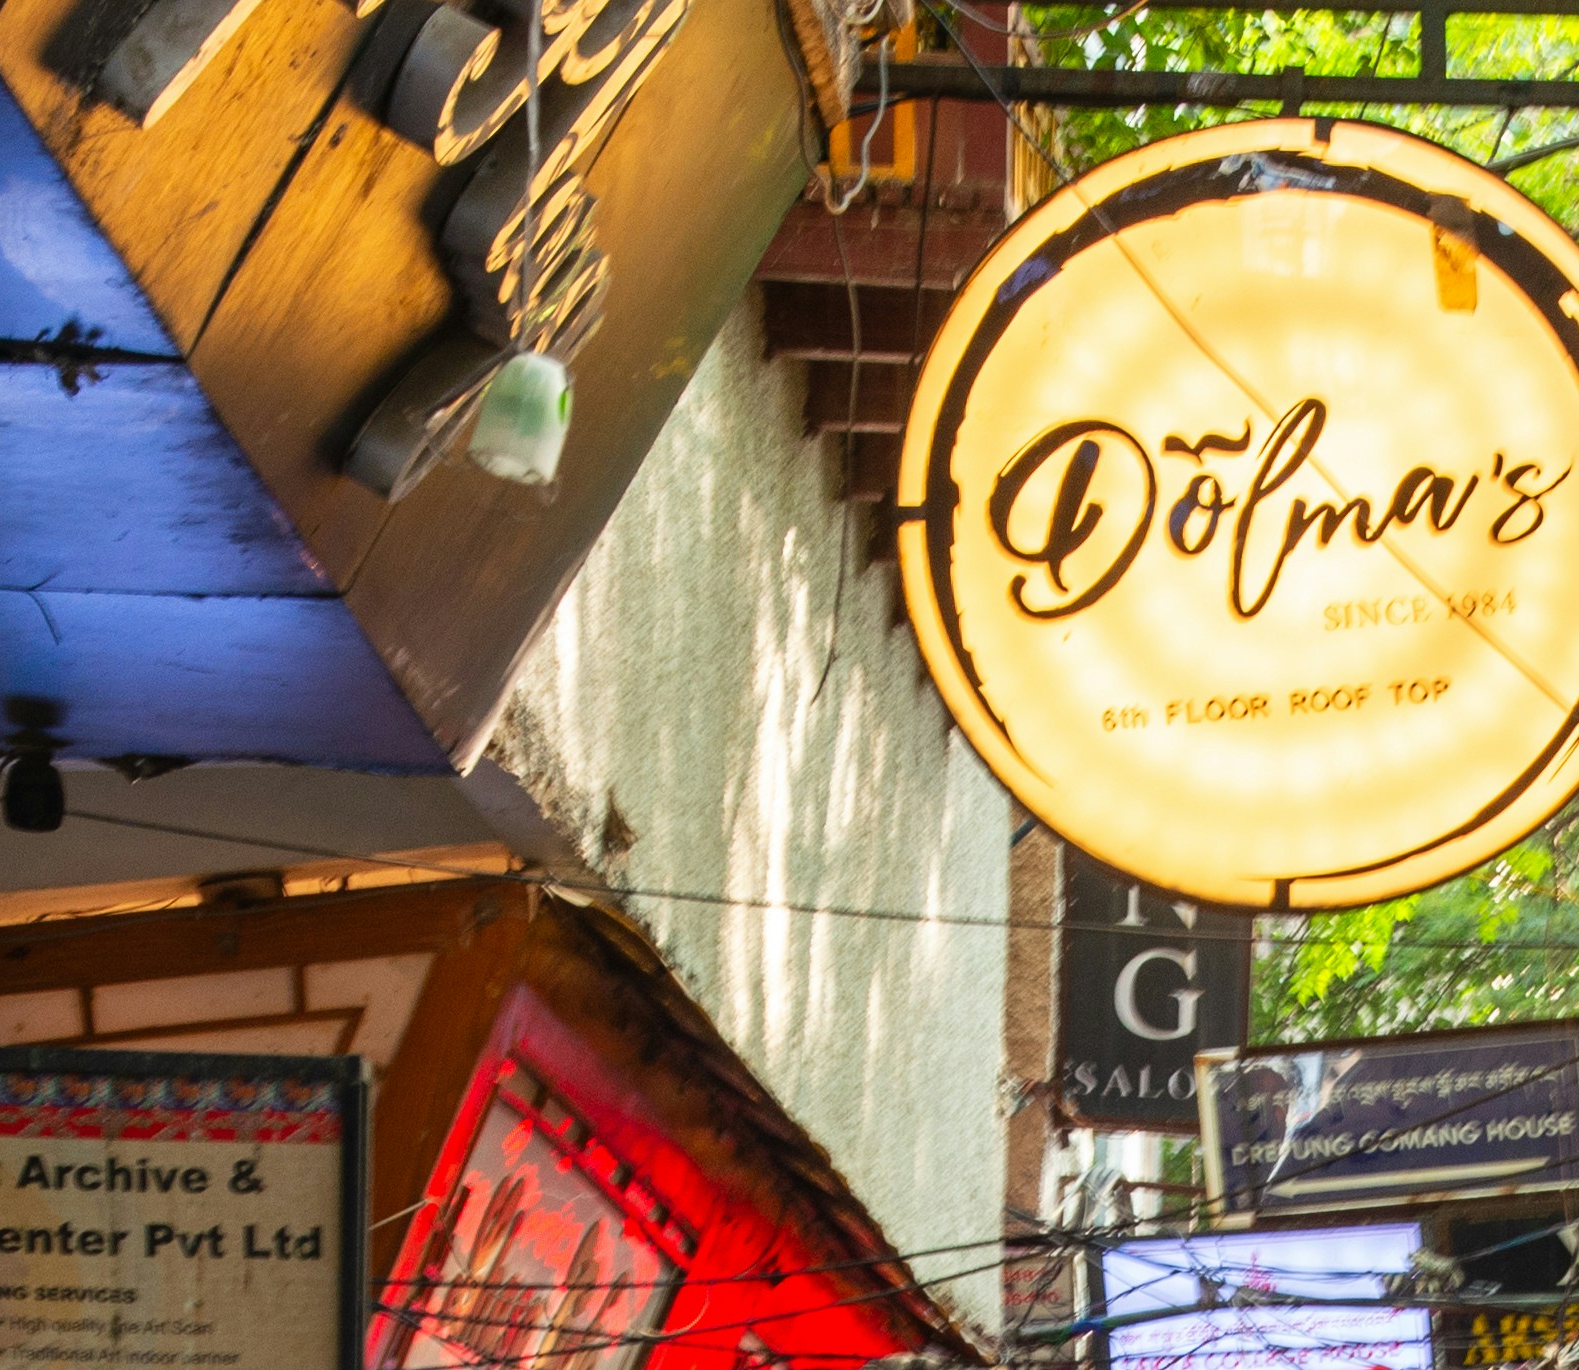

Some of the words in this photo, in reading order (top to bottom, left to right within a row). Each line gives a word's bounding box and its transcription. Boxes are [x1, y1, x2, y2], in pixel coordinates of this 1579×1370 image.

[1324, 599, 1430, 632] SINCE
[1443, 588, 1519, 620] 1984
[1102, 702, 1149, 732] 6th
[1165, 692, 1270, 725] FLOOR
[1289, 683, 1374, 717] ROOF
[1387, 676, 1452, 707] TOP
[1074, 1060, 1197, 1101] SALO
[1231, 1131, 1356, 1167] DREUNG
[1485, 1110, 1578, 1143] HOUSE
[14, 1153, 209, 1194] Archive
[227, 1158, 266, 1194] &
[143, 1222, 226, 1260] Pvt
[242, 1223, 324, 1262] Ltd
[34, 1286, 138, 1304] SERVICES
